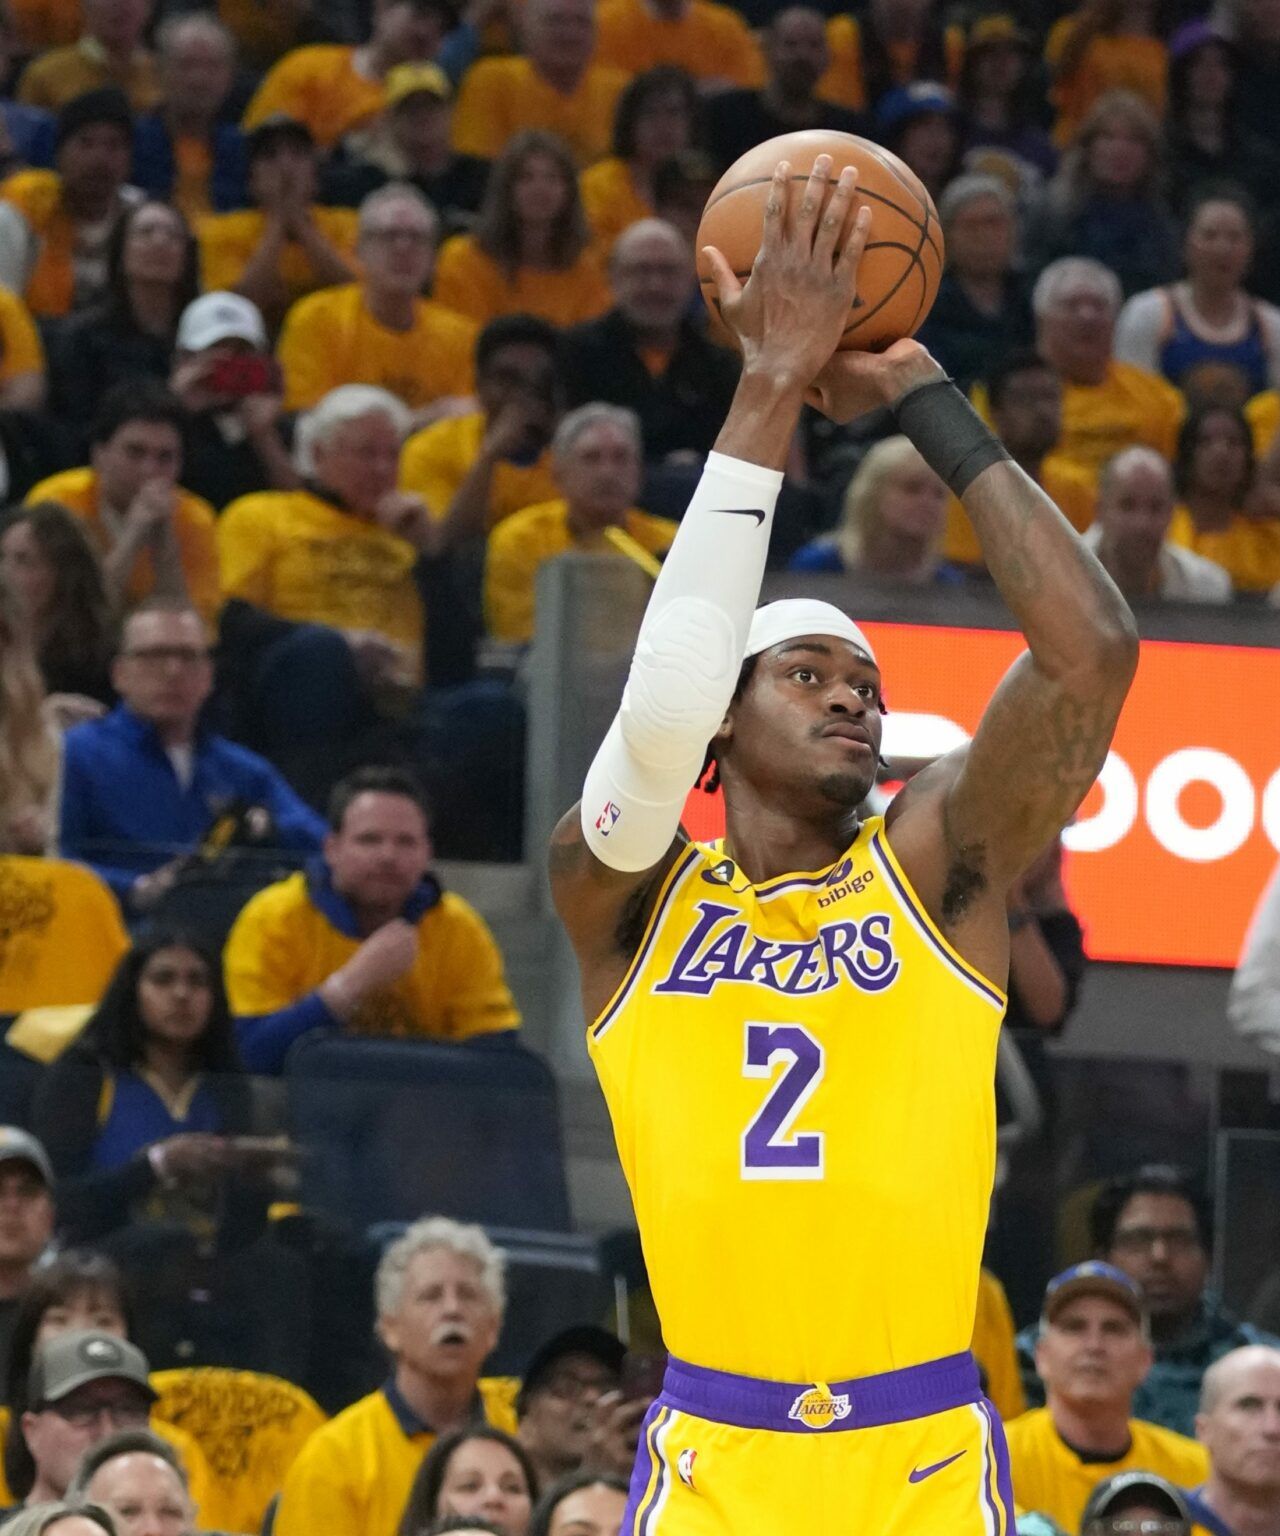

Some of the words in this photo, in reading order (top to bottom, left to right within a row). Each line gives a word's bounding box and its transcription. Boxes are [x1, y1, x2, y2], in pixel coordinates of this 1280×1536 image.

[817, 869, 874, 908] bibigo
[652, 900, 901, 996] LAKERS
[740, 1020, 825, 1181] 2
[792, 1398, 846, 1418] LAKERS
